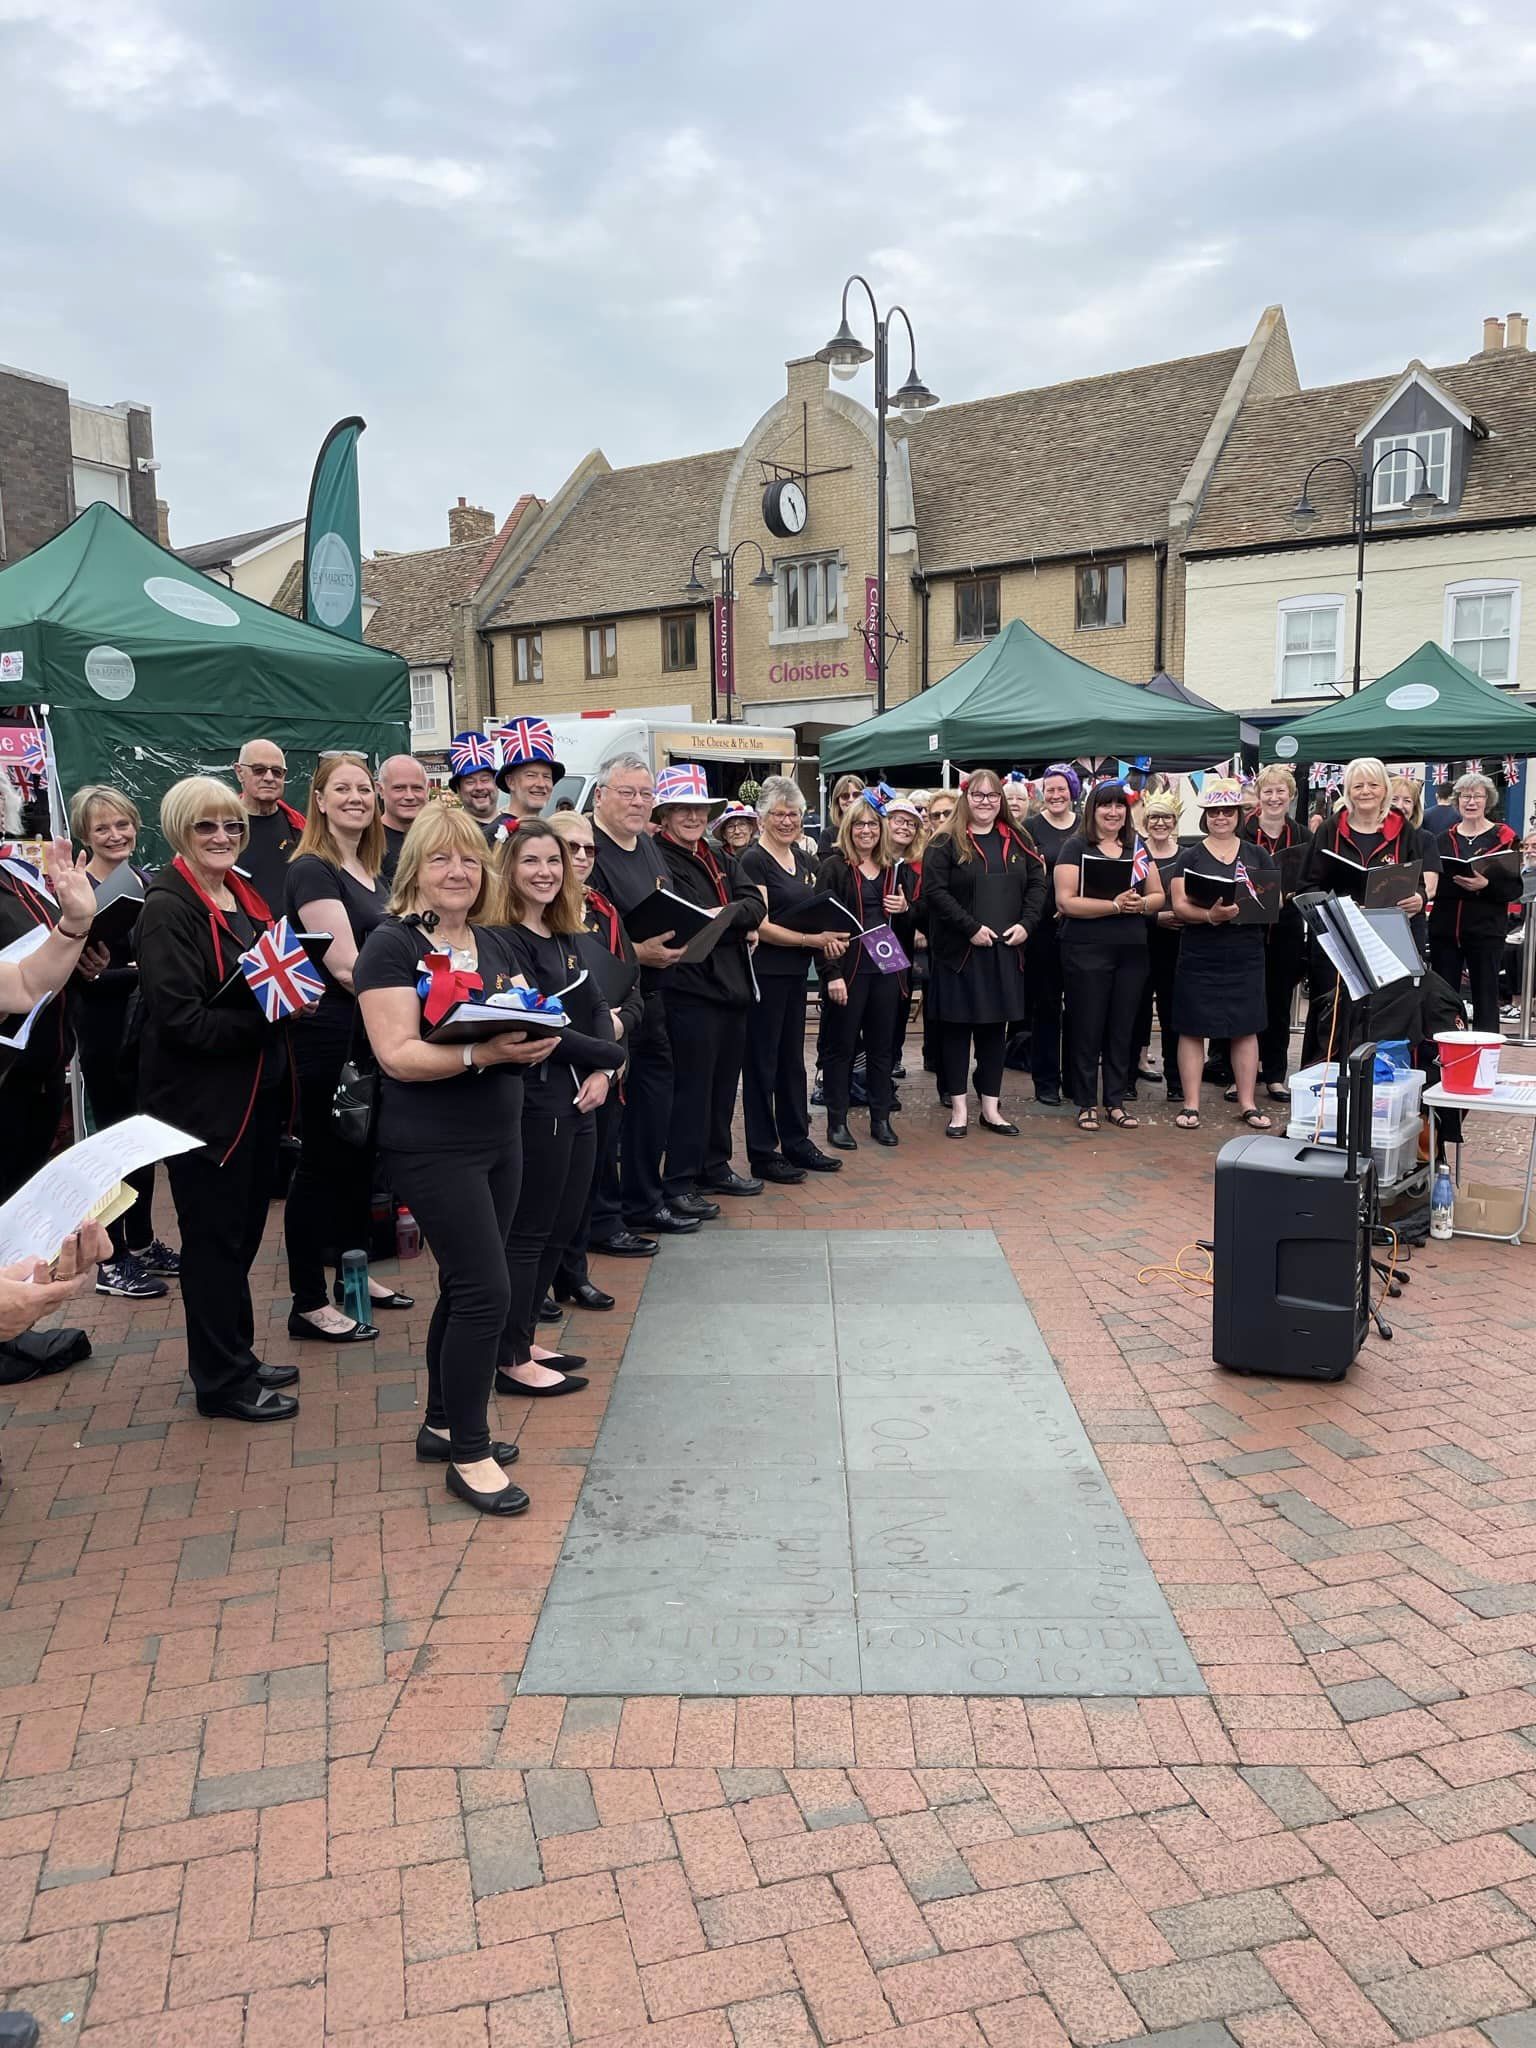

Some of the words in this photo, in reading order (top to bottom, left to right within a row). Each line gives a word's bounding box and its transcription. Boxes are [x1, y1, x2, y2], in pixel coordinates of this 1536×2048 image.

[769, 662, 849, 685] Cloisters
[691, 736, 705, 747] The
[706, 736, 730, 748] Cheese
[731, 738, 737, 748] &
[738, 737, 749, 748] Pie
[750, 738, 764, 749] Man
[871, 1418, 937, 1480] Oct
[867, 1510, 953, 1579] Nov
[865, 1626, 1173, 1650] LONGITUDE
[799, 1656, 834, 1683] N
[1153, 1656, 1189, 1684] E
